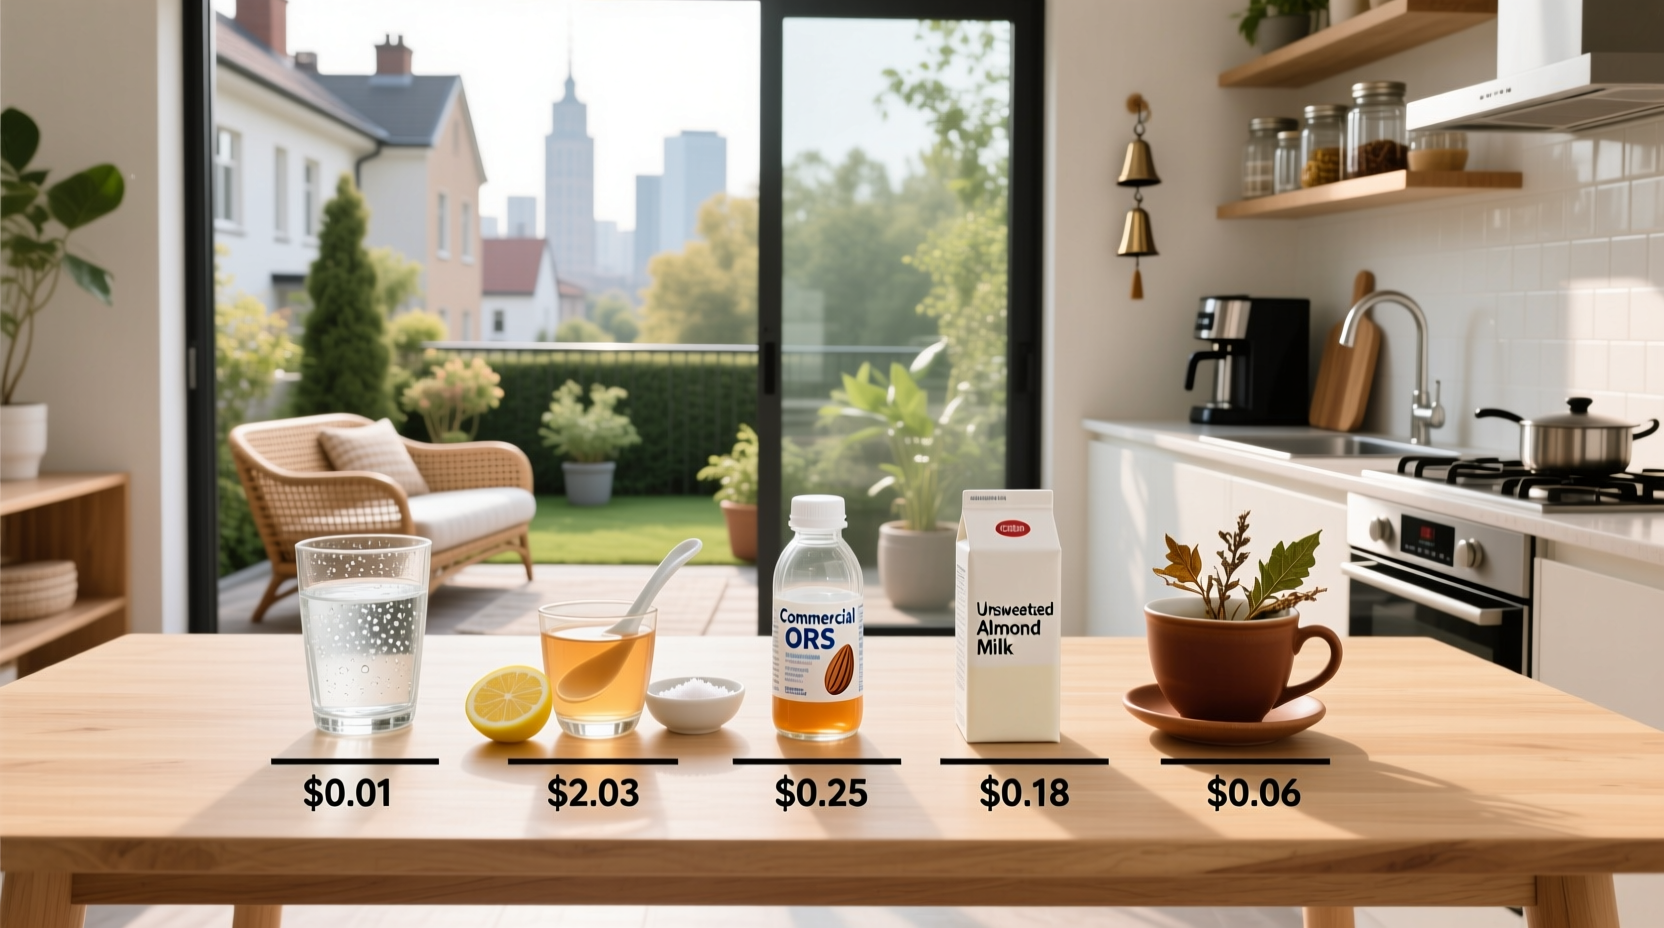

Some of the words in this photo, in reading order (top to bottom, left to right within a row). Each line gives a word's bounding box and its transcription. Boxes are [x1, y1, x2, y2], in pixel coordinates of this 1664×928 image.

[779, 607, 856, 625] Commercial
[976, 619, 1042, 636] Almond
[785, 627, 835, 650] ORS
[977, 638, 1014, 656] Milk
